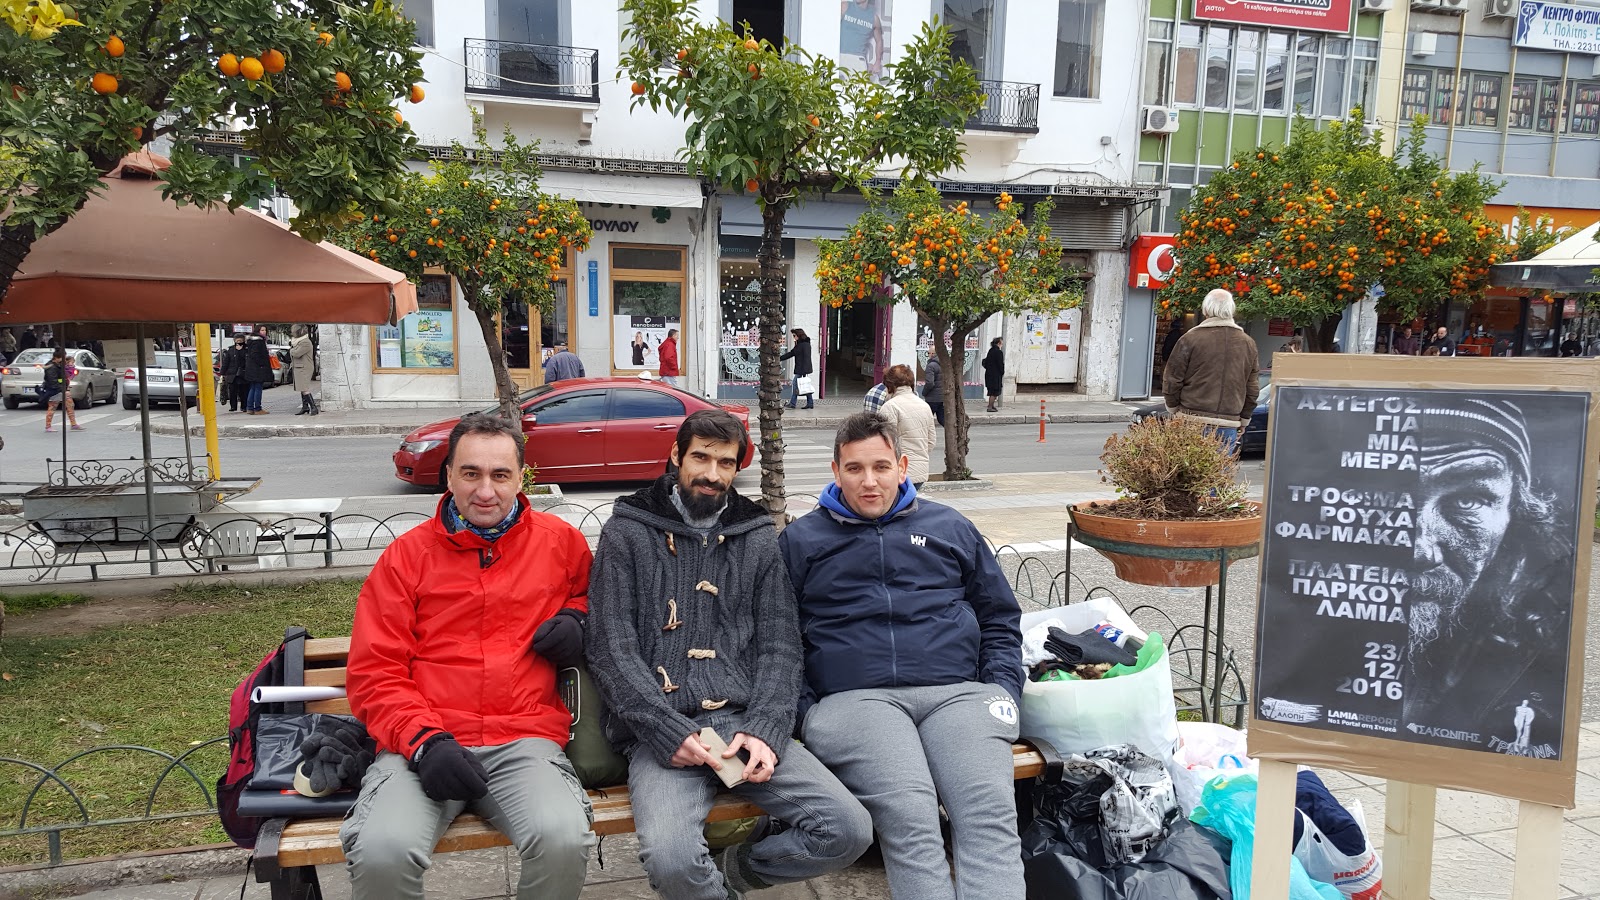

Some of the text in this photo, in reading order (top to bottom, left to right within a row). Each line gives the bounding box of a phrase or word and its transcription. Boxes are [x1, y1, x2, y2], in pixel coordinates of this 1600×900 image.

[1543, 6, 1600, 25] ΚΕΝΤΡΟ ΦΥΣΙΚ
[1296, 394, 1421, 414] ΑΣΤΕΓΟΣ
[1375, 415, 1420, 433] ΓΙΑ
[1367, 433, 1419, 452] ΜΙΑ
[1340, 451, 1418, 471] ΜΕΡΑ
[1287, 485, 1415, 510] ΤΡΟΦΙΜΑ
[1320, 505, 1414, 529] ΡΟΥΧΑ
[1275, 521, 1412, 548] ΦΑΡΜΑΚΑ
[1288, 559, 1409, 587] ΠΛΑΤΕΙΑ
[1292, 577, 1409, 605] ΠΑΡΚΟΥ
[1316, 599, 1407, 624] ΛΑΜΙΑ
[1335, 676, 1403, 700] 2016
[1341, 719, 1361, 728] Portal
